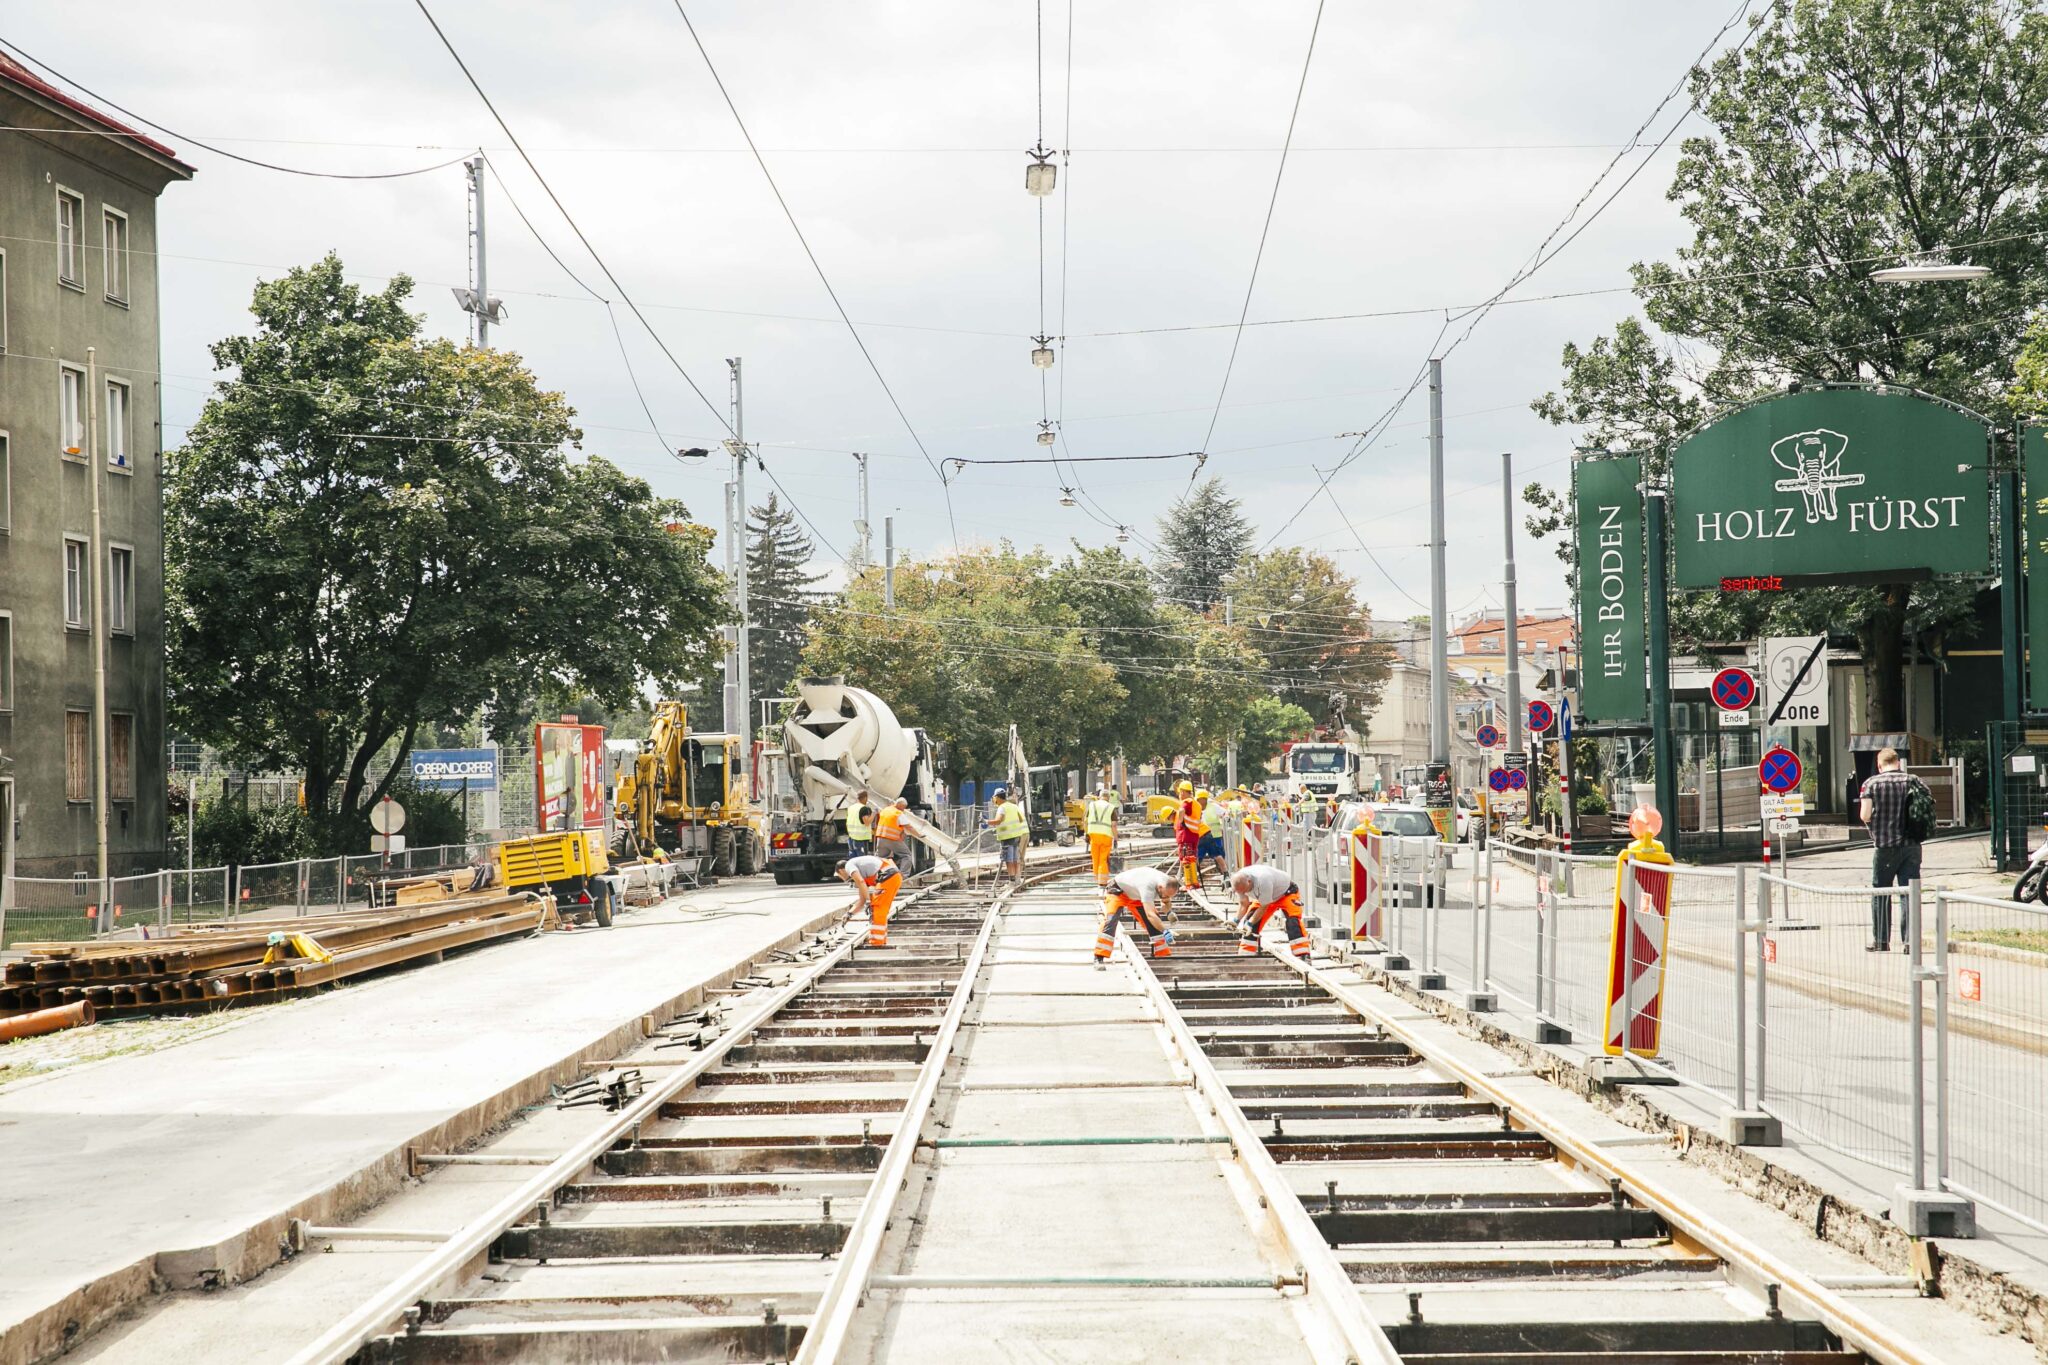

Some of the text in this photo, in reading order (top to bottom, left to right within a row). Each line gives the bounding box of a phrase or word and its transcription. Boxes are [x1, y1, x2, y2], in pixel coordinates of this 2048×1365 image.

[1696, 495, 1966, 542] HOLZ FÜRST
[1598, 505, 1625, 678] IHR BODEN
[1781, 655, 1812, 687] 30
[1724, 714, 1744, 723] Ende
[414, 761, 494, 775] OBERNDORFER
[1776, 822, 1793, 830] Ende
